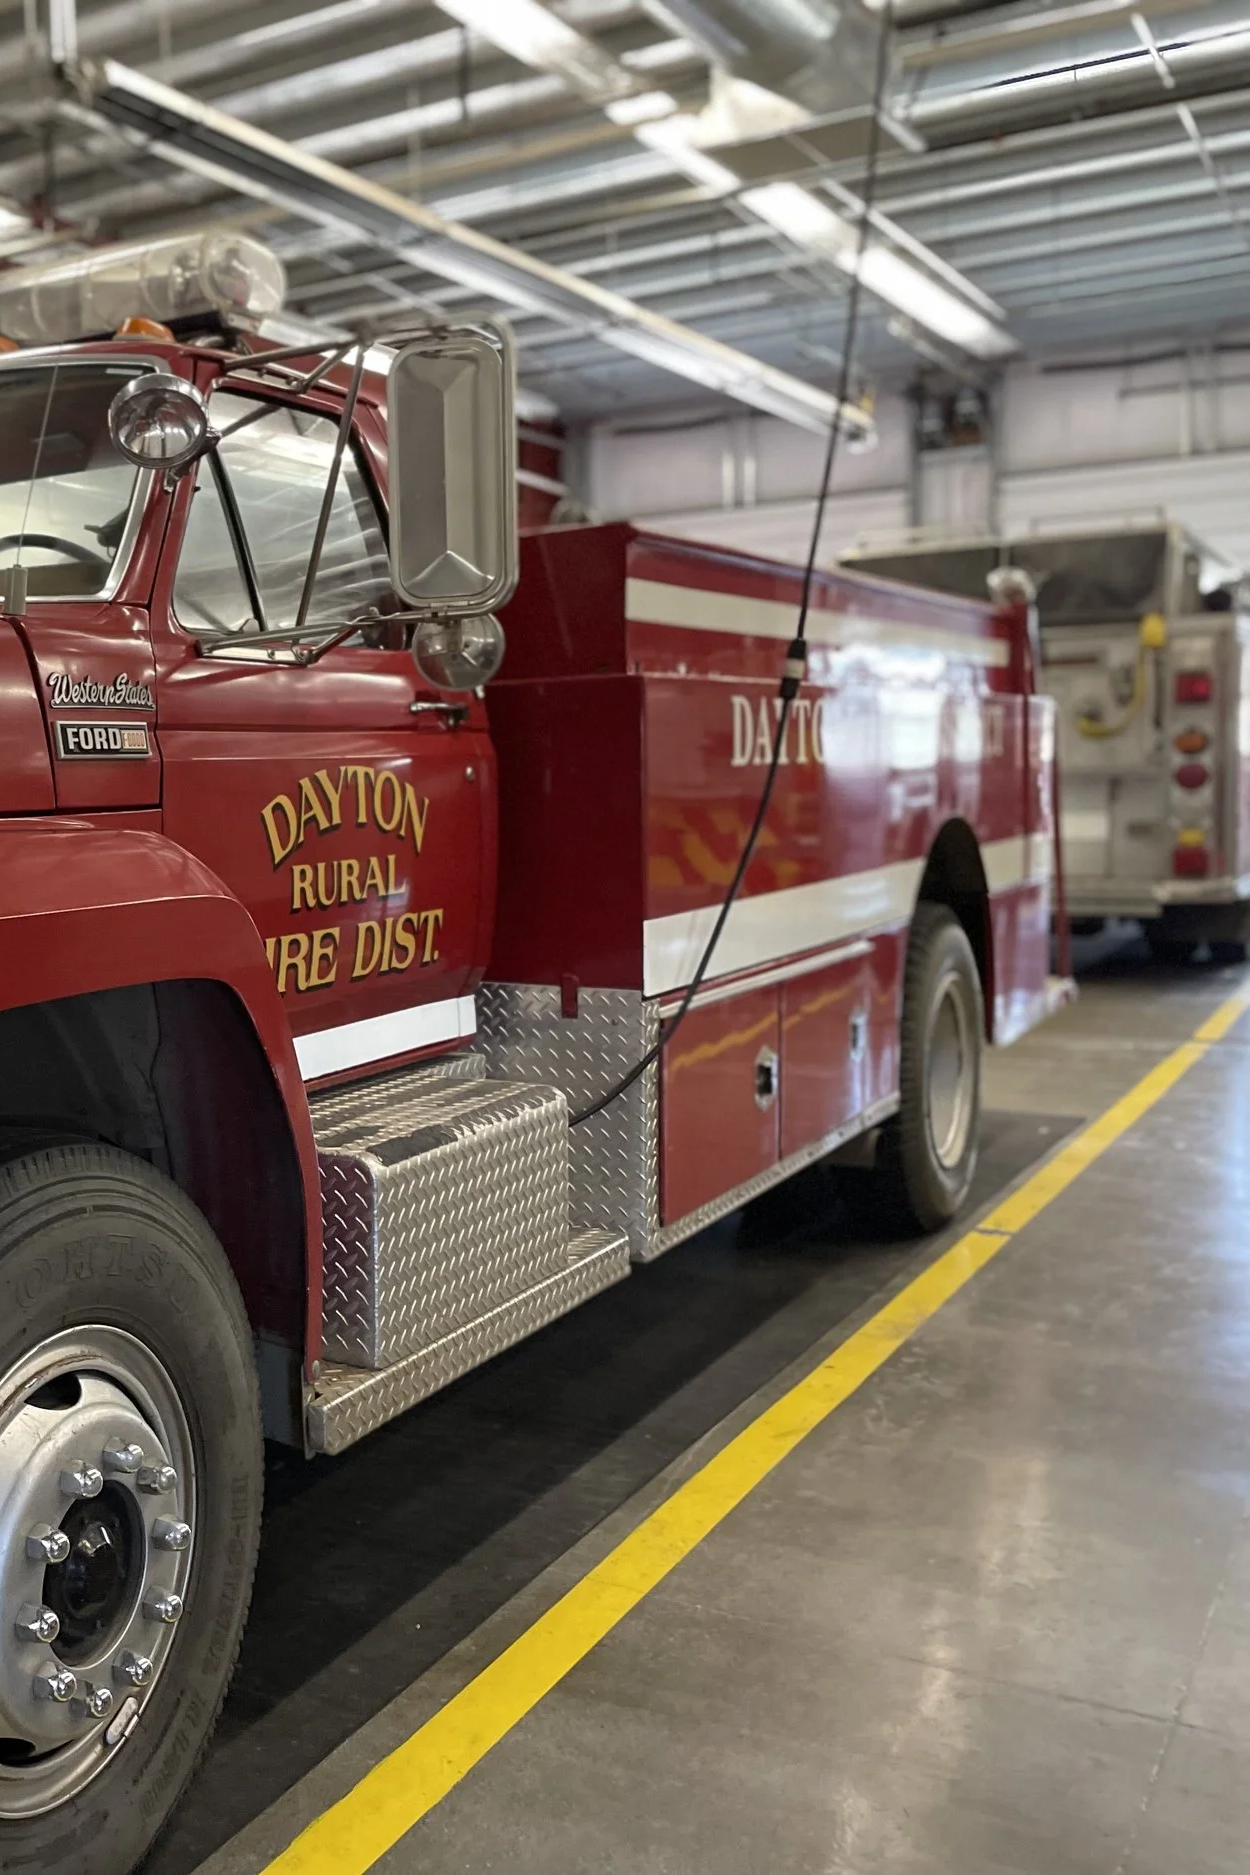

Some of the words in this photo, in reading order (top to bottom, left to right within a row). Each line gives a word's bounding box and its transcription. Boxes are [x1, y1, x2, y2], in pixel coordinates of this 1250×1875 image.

[66, 727, 122, 750] FORD
[730, 694, 829, 768] DAYTO
[261, 765, 430, 865] DAYTON
[291, 854, 407, 910] RURAL
[265, 927, 341, 993] RE
[352, 908, 444, 979] DIST.
[15, 1232, 199, 1313] OHTSU
